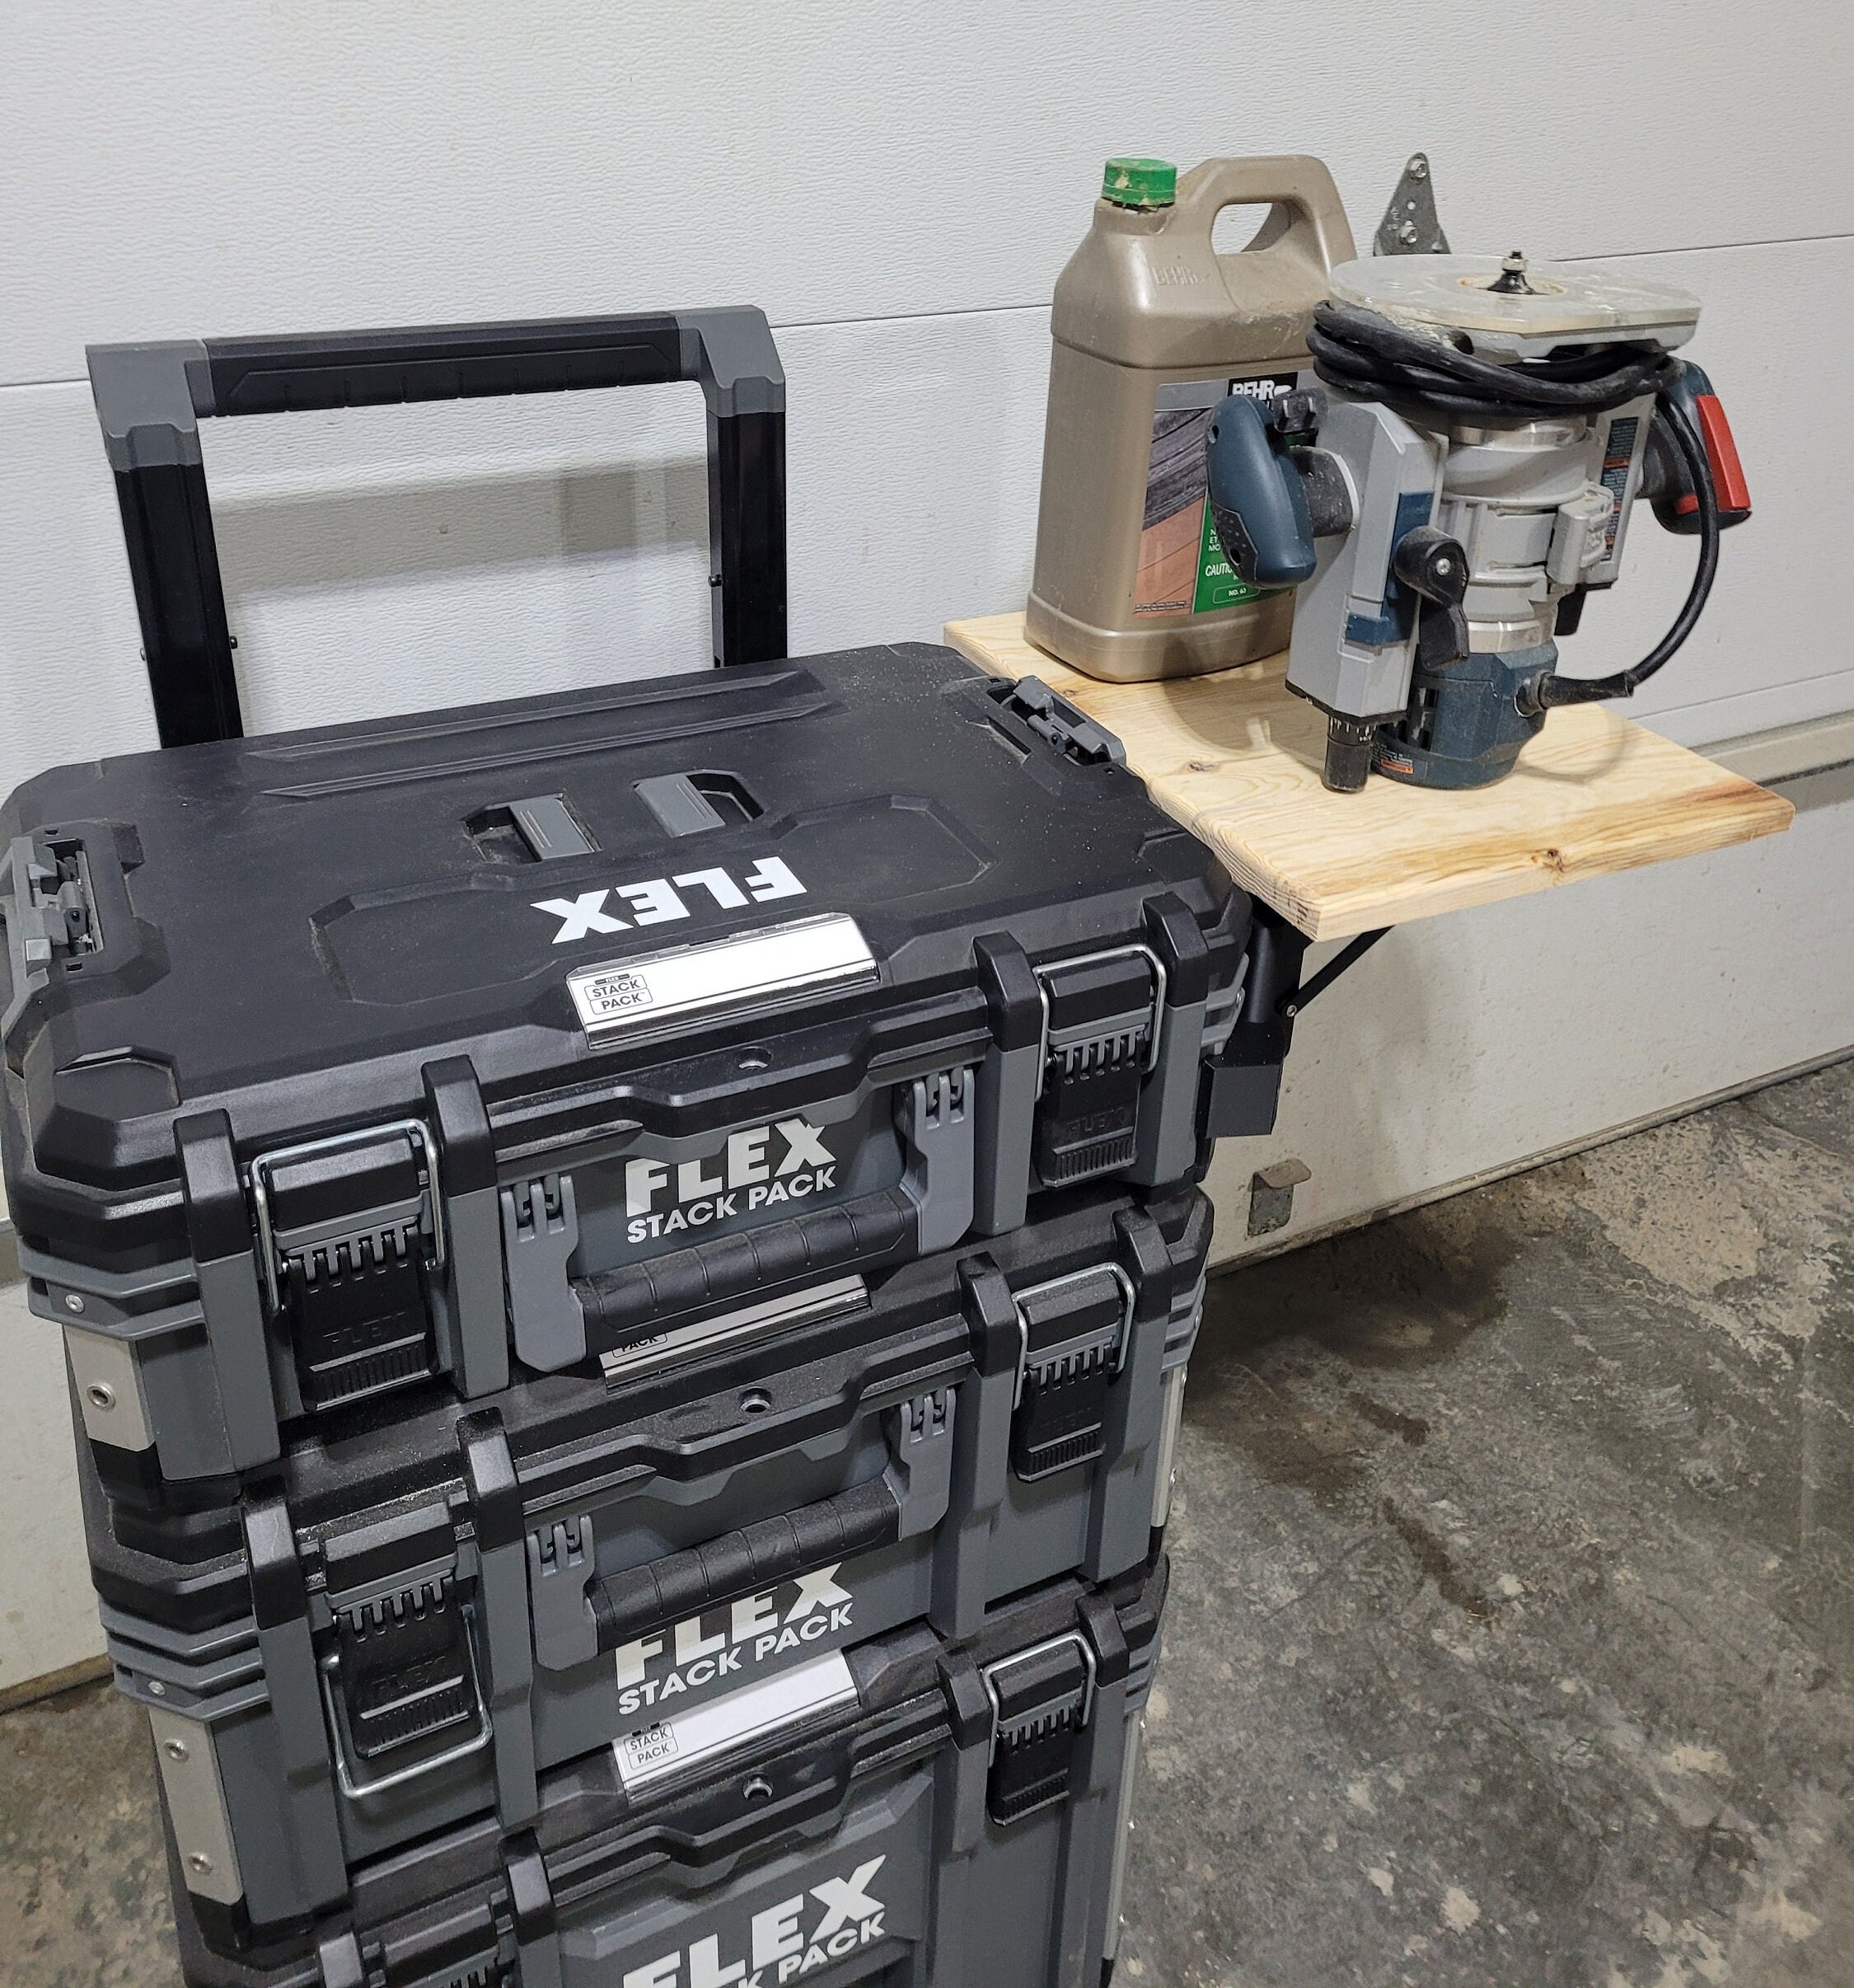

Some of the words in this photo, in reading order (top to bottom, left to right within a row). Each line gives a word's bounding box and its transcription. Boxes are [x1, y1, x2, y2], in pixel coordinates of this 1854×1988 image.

[1232, 379, 1275, 401] BEHR
[1205, 562, 1233, 576] CAUTIO
[530, 856, 808, 945] FLEX
[592, 979, 641, 997] STACK
[601, 992, 643, 1010] PACK
[625, 1117, 837, 1217] FLEX
[627, 1193, 737, 1244] STACK
[748, 1165, 836, 1210] PACK
[616, 1561, 854, 1690] FLEX
[618, 1646, 742, 1715] STACK
[755, 1601, 854, 1662] PACK
[630, 1728, 668, 1750] STACK
[637, 1742, 670, 1764] PACK
[623, 1854, 887, 1988] FLEX
[778, 1911, 886, 1984] PACK
